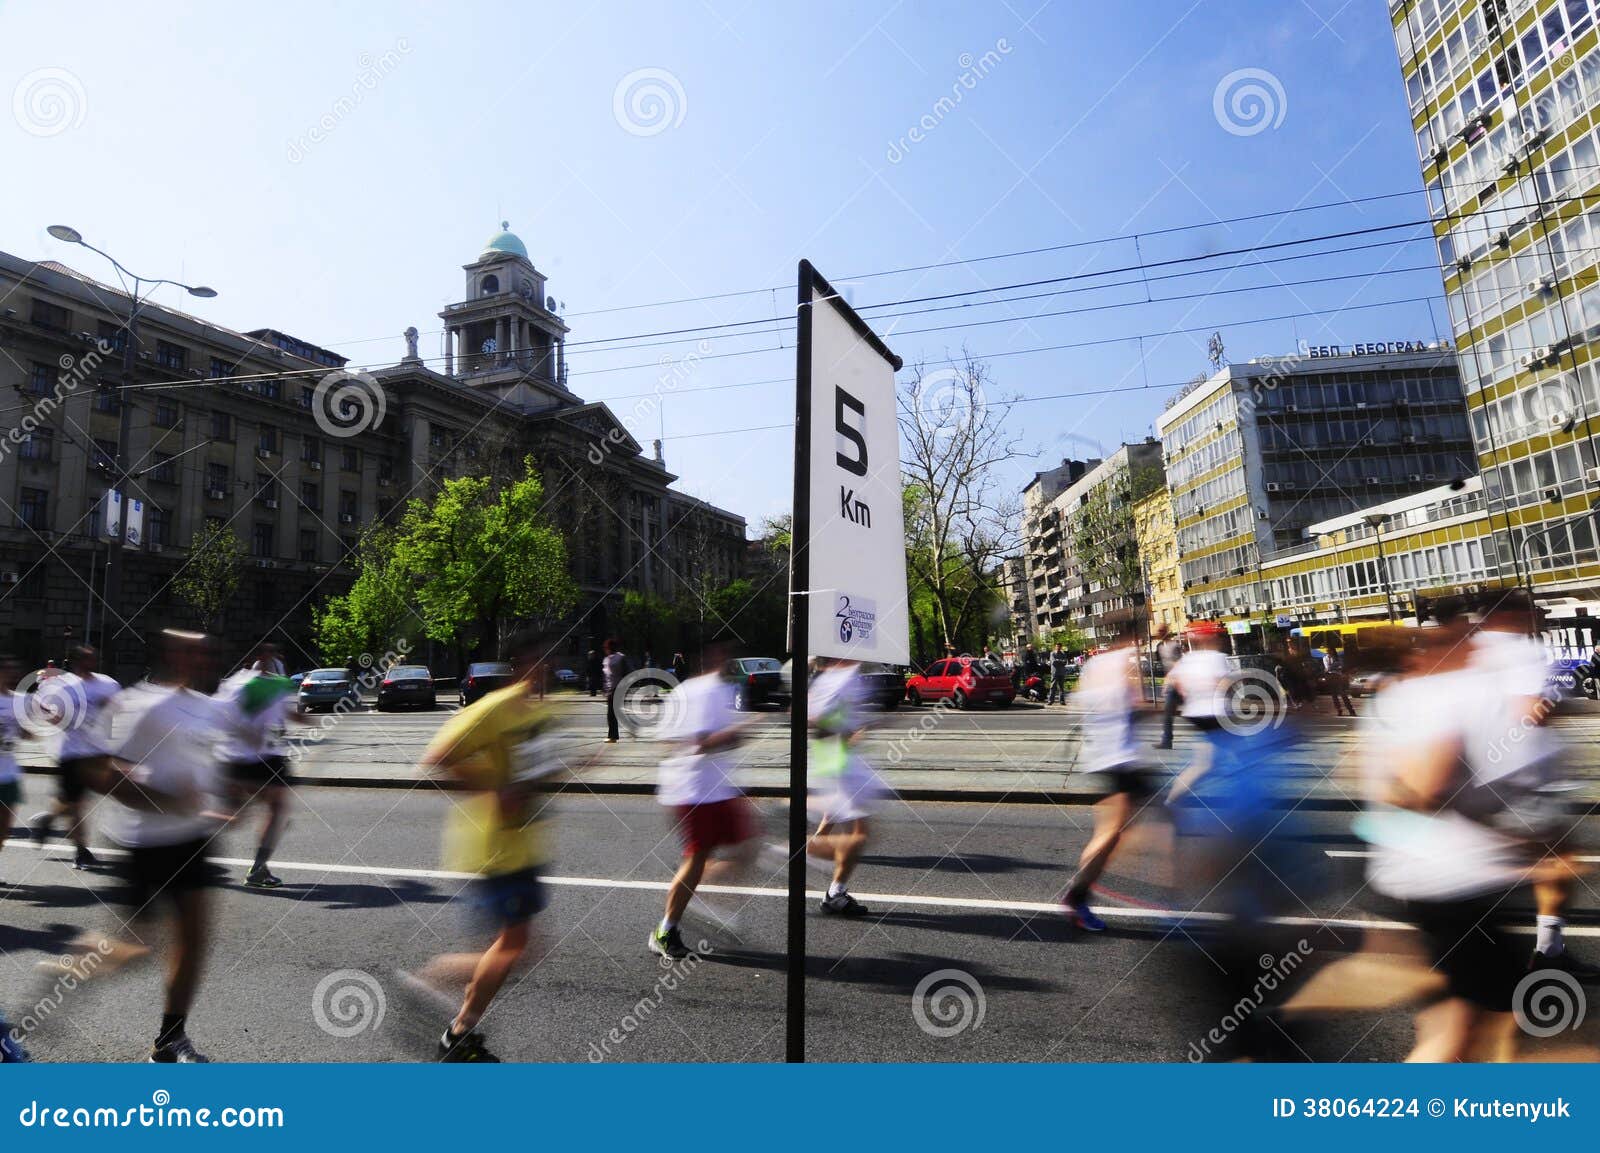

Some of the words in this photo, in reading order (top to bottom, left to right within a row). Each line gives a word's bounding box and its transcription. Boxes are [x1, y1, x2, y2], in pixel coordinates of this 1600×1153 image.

[1308, 345, 1340, 358] ББП
[835, 384, 868, 477] 5
[840, 485, 871, 529] Km
